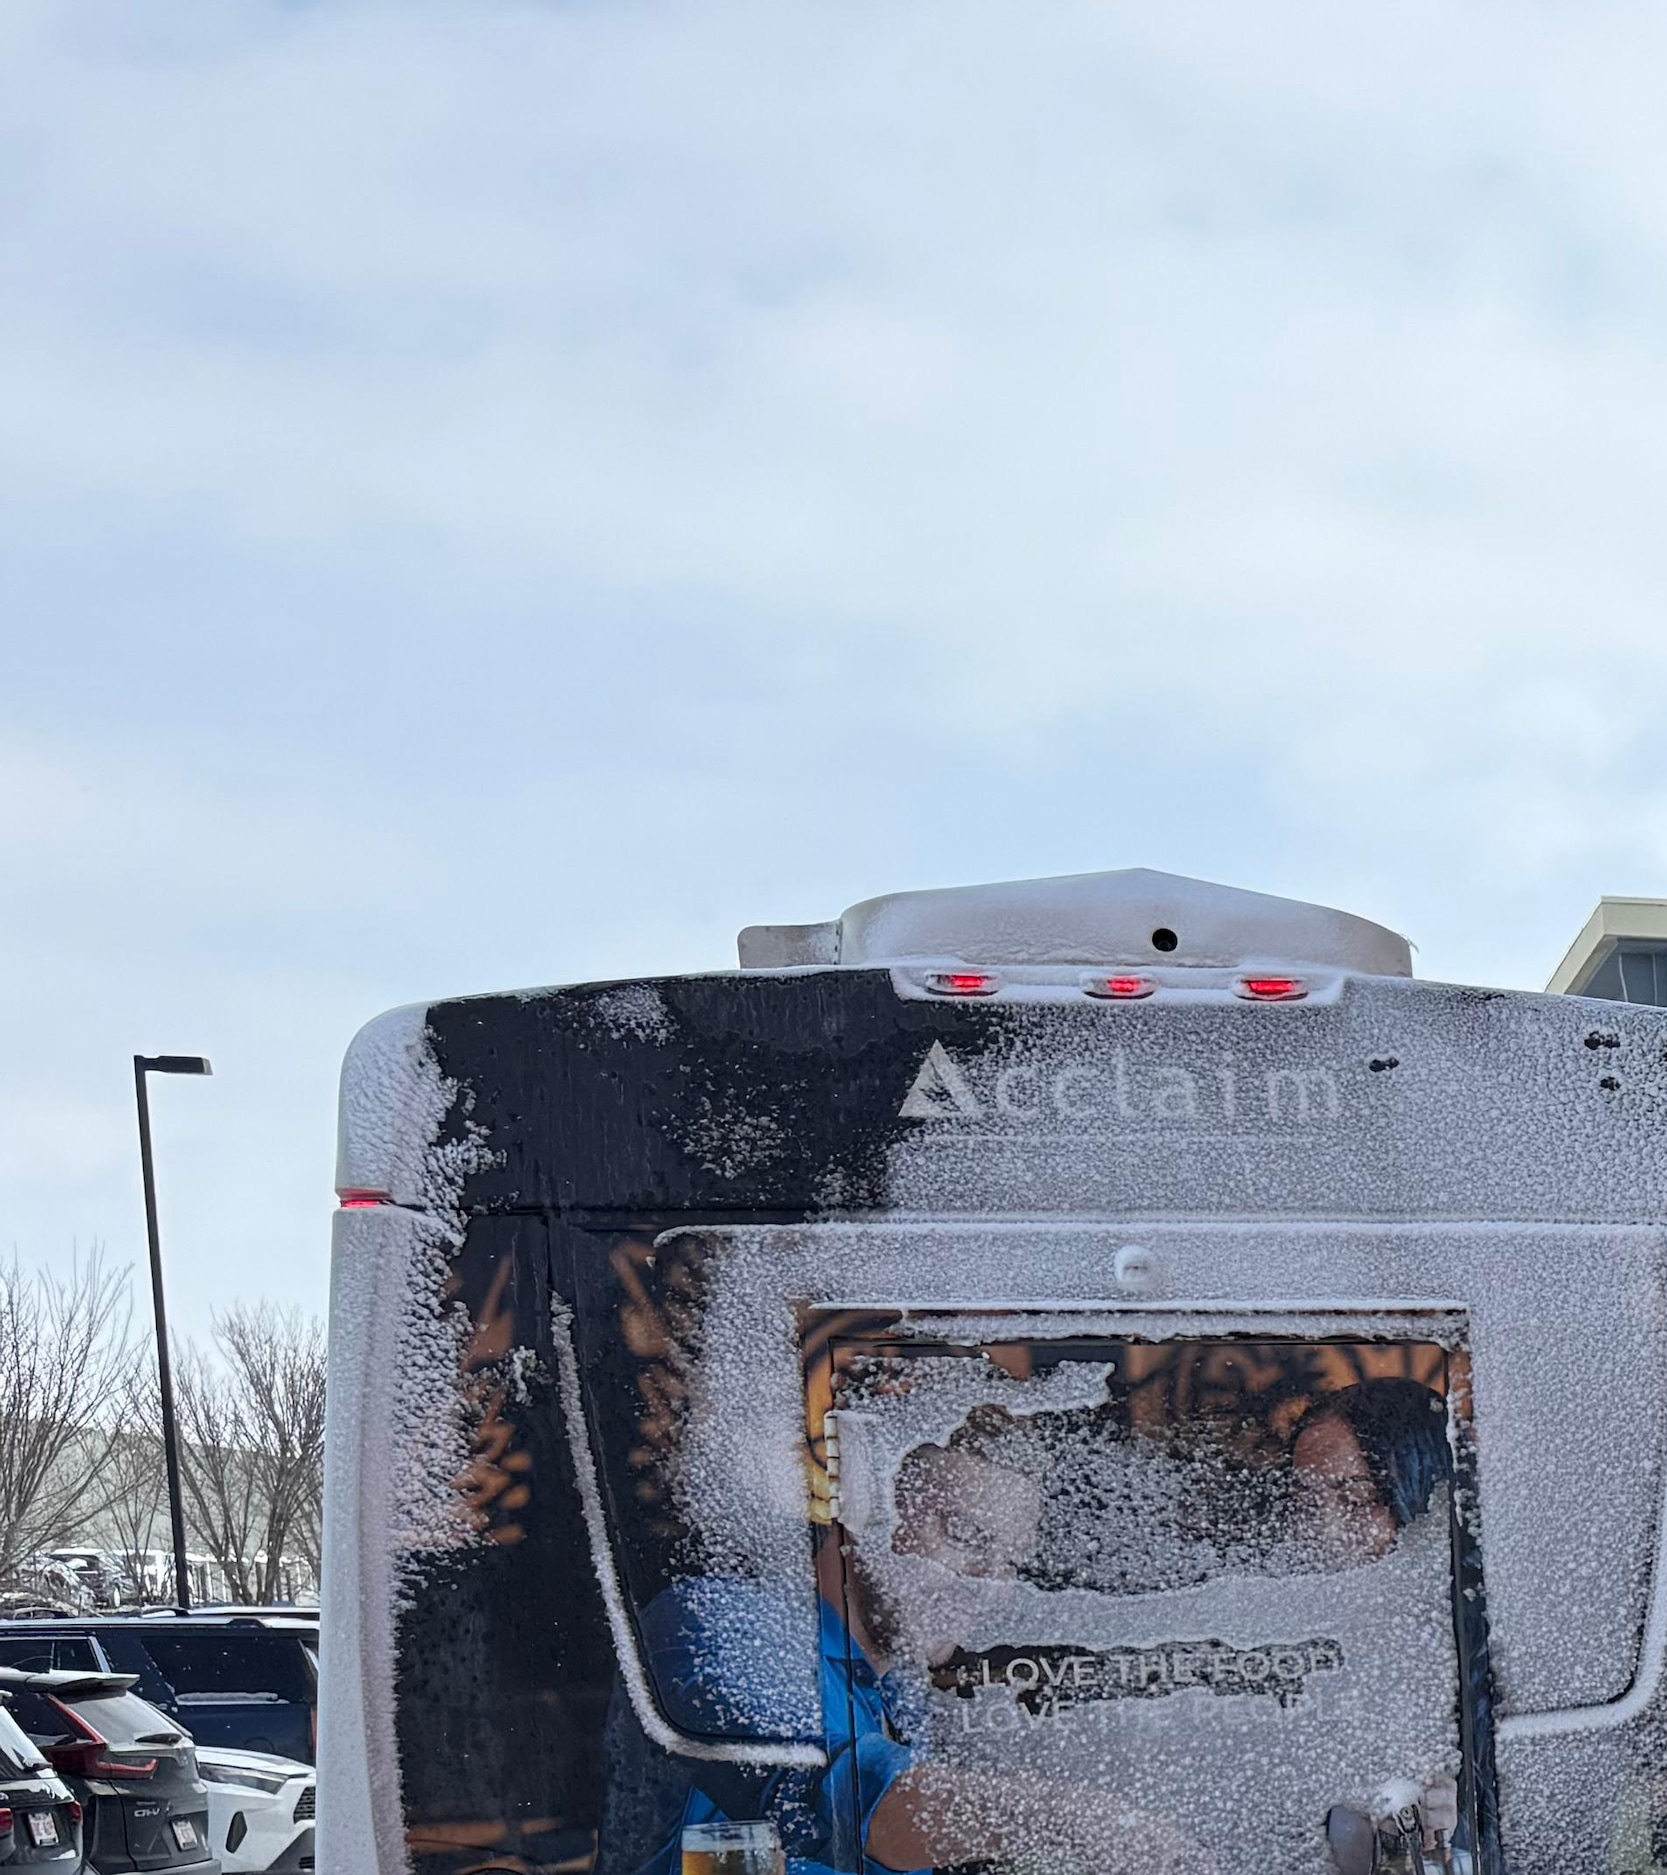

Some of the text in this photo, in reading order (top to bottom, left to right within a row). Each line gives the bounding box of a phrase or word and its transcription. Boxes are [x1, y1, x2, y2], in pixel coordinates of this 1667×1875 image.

[898, 1038, 1340, 1120] Acclaim
[981, 1649, 1344, 1689] LOVE THE FOOD
[961, 1700, 1079, 1734] LOVE
